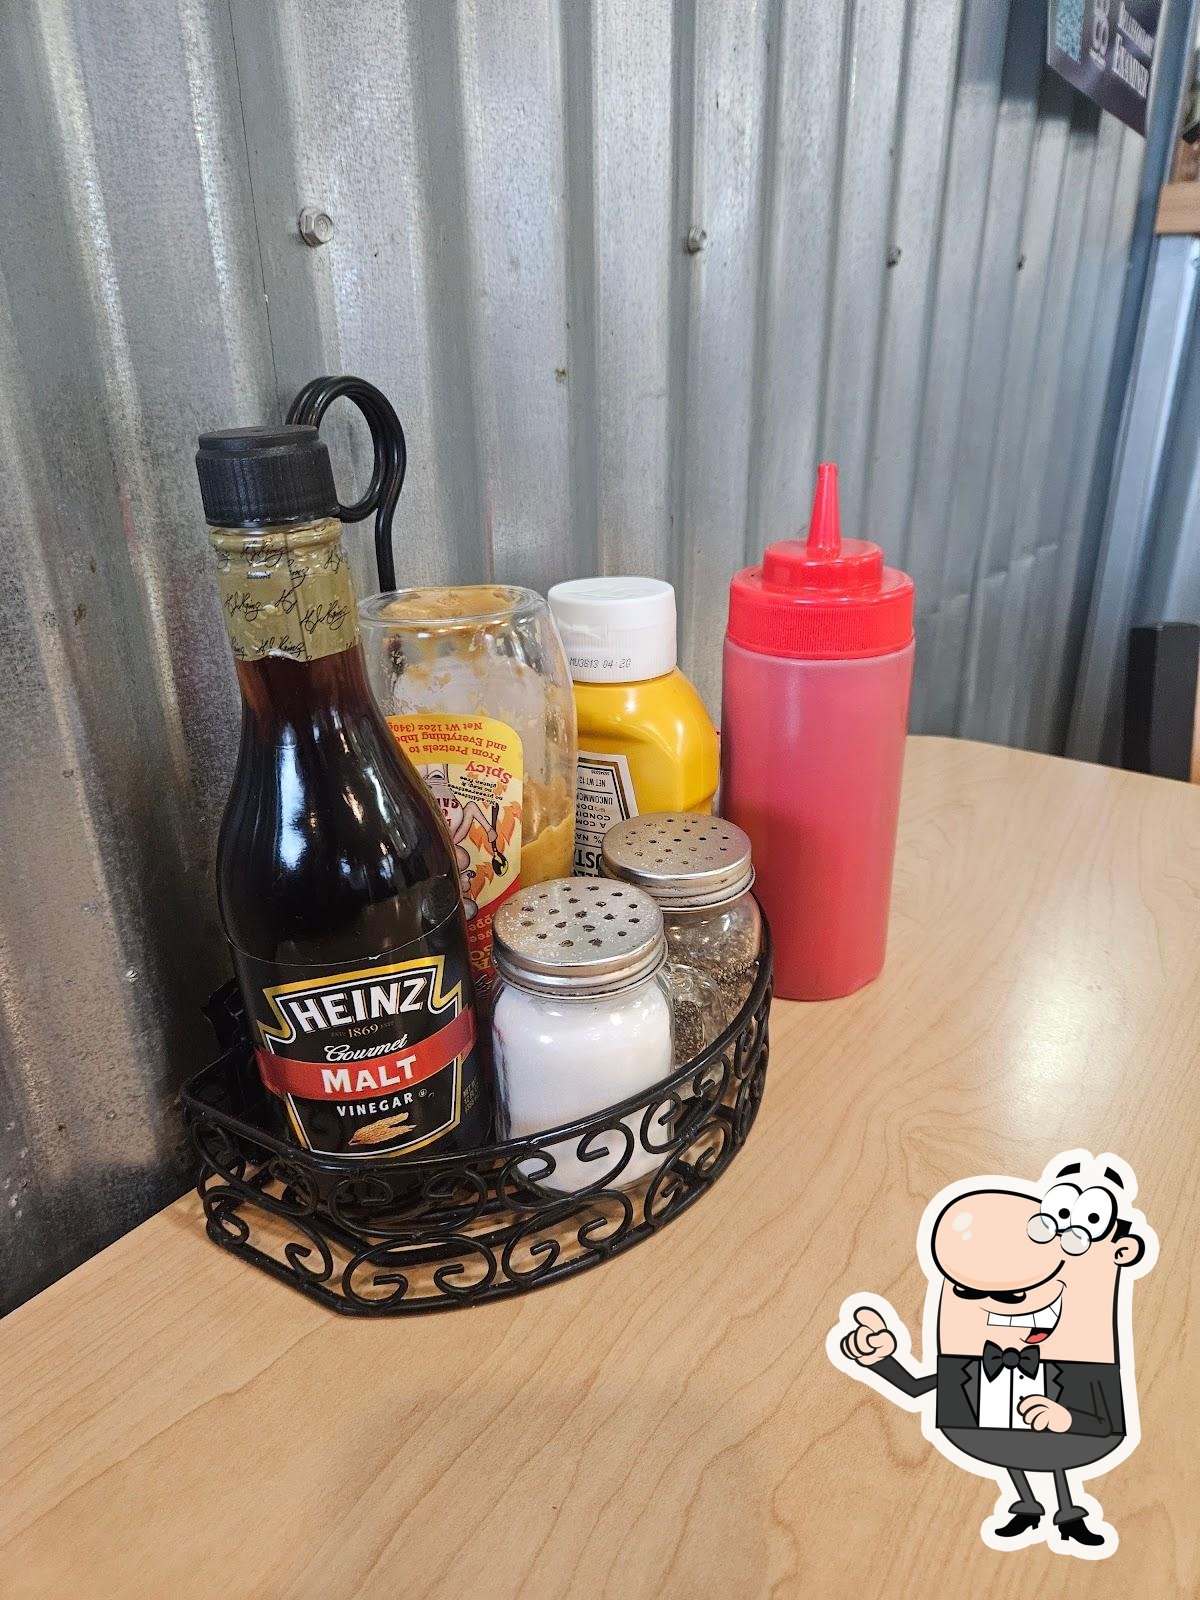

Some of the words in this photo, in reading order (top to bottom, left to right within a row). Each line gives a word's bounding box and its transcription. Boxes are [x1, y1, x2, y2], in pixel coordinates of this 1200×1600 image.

[418, 724, 442, 732] 12oz
[444, 723, 460, 732] Wt
[463, 722, 483, 731] Net
[421, 732, 484, 747] Everything
[409, 746, 420, 754] to
[422, 744, 469, 755] Pretzels
[486, 740, 508, 753] and
[471, 748, 501, 763] From
[465, 761, 513, 784] Spicy
[475, 780, 497, 788] gluten
[586, 777, 595, 786] WT
[595, 779, 606, 787] NET
[288, 976, 427, 1033] HEINZ
[348, 1023, 379, 1039] 1869
[323, 1033, 408, 1062] Gourmet
[320, 1054, 417, 1094] MALT
[336, 1091, 414, 1117] VINEGAR
